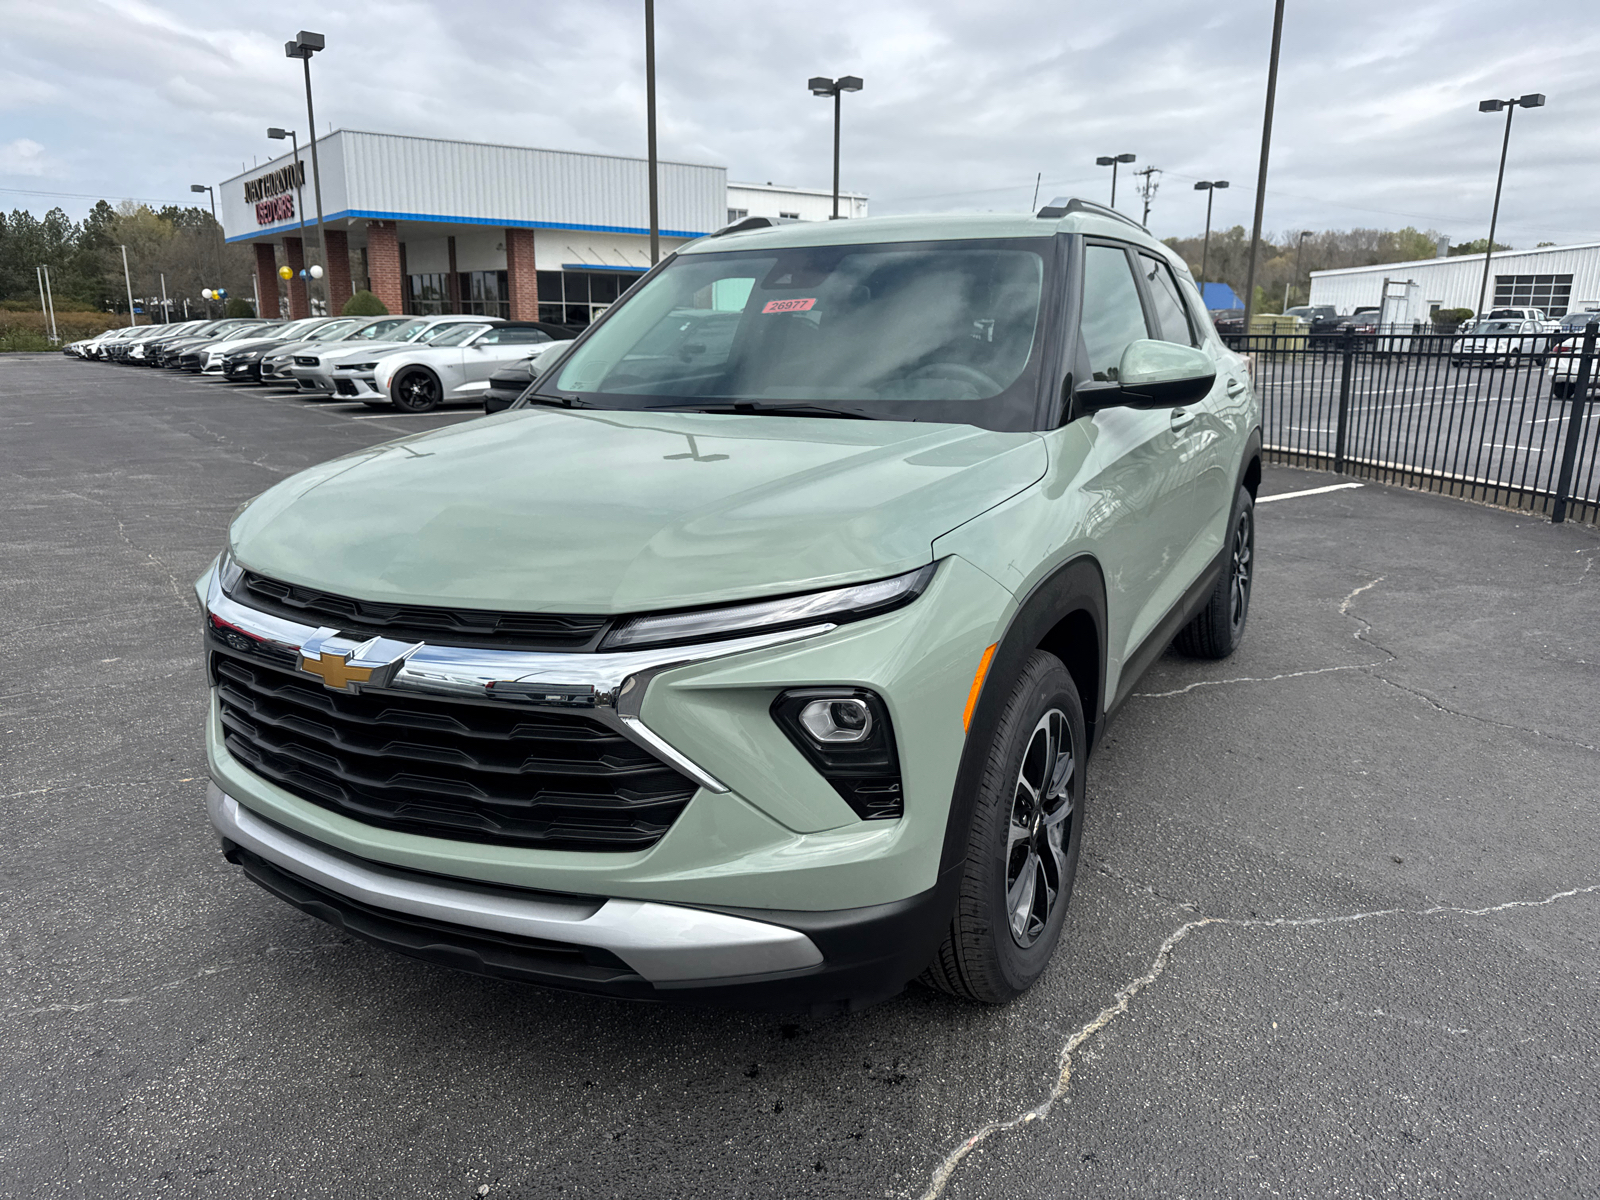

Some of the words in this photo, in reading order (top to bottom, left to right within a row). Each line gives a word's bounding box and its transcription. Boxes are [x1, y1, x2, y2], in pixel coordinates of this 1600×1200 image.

[255, 199, 274, 225] USED
[273, 194, 295, 221] CARS
[769, 300, 808, 310] 26977
